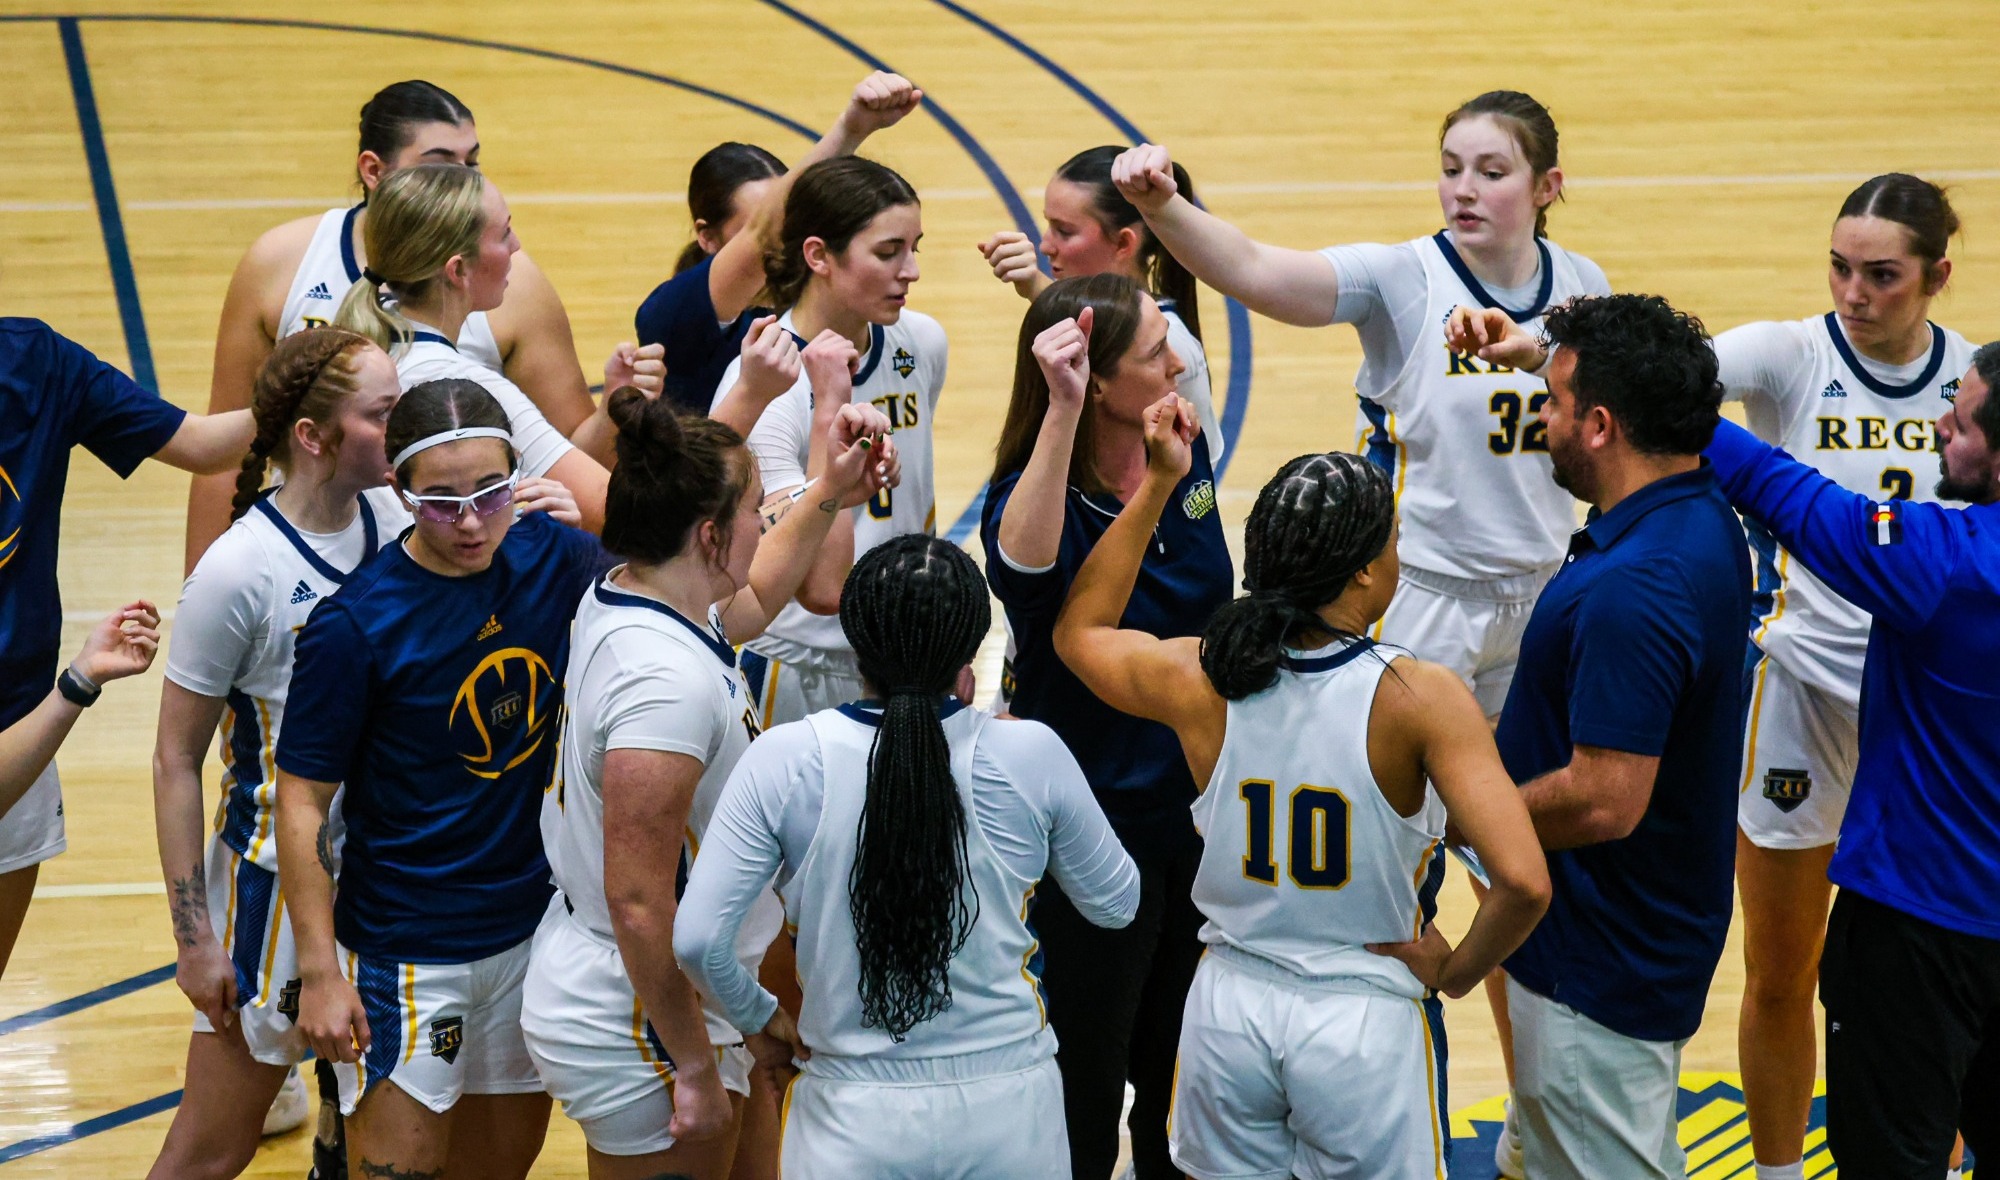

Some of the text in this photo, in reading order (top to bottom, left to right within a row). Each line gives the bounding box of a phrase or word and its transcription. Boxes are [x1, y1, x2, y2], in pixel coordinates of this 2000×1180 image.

[304, 292, 333, 300] adidas
[1821, 388, 1847, 398] adidas
[1488, 389, 1550, 456] 32
[290, 591, 318, 604] adidas
[477, 623, 503, 641] adidas
[1239, 778, 1351, 890] 10
